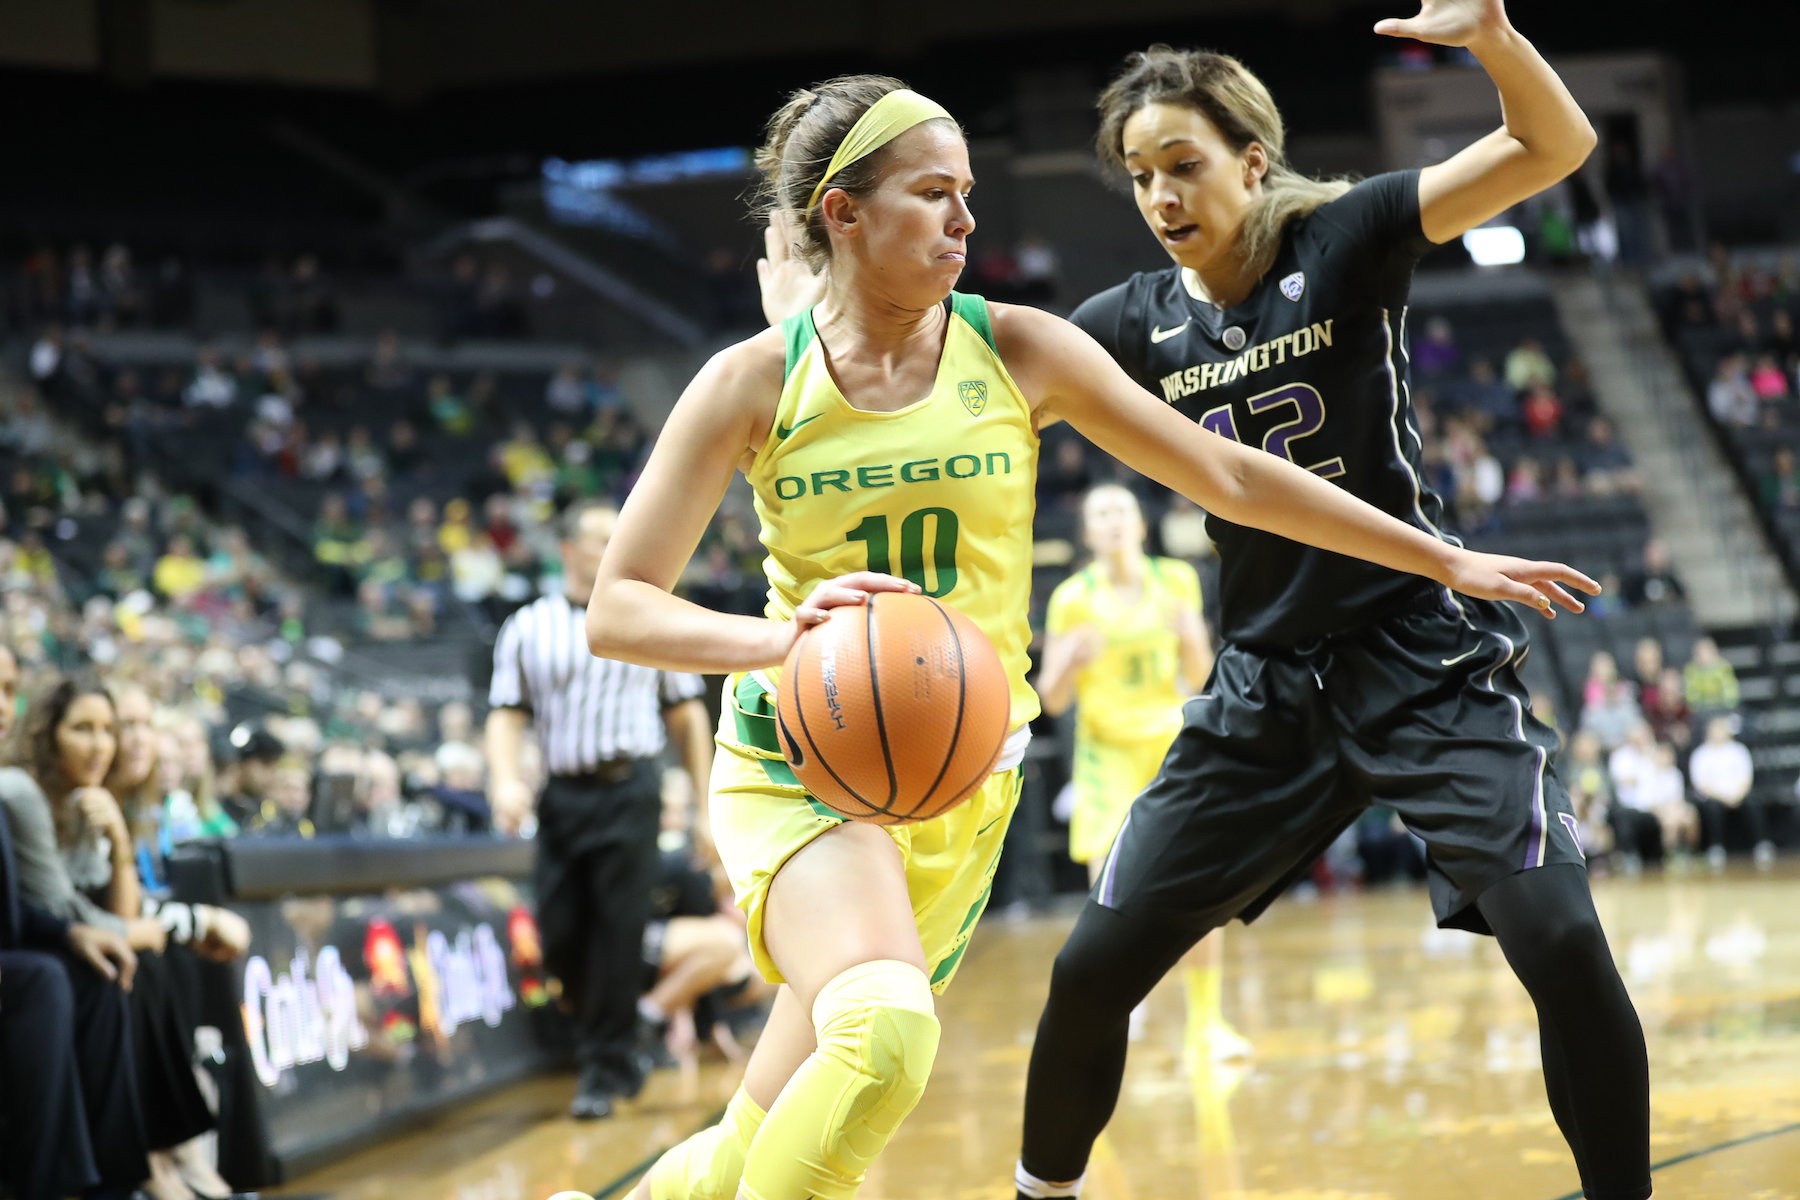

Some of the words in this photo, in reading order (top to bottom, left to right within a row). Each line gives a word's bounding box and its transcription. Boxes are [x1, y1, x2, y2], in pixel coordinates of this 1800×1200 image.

[1160, 319, 1334, 403] WASHINGTON
[775, 452, 1011, 500] OREGON
[846, 507, 959, 598] 10
